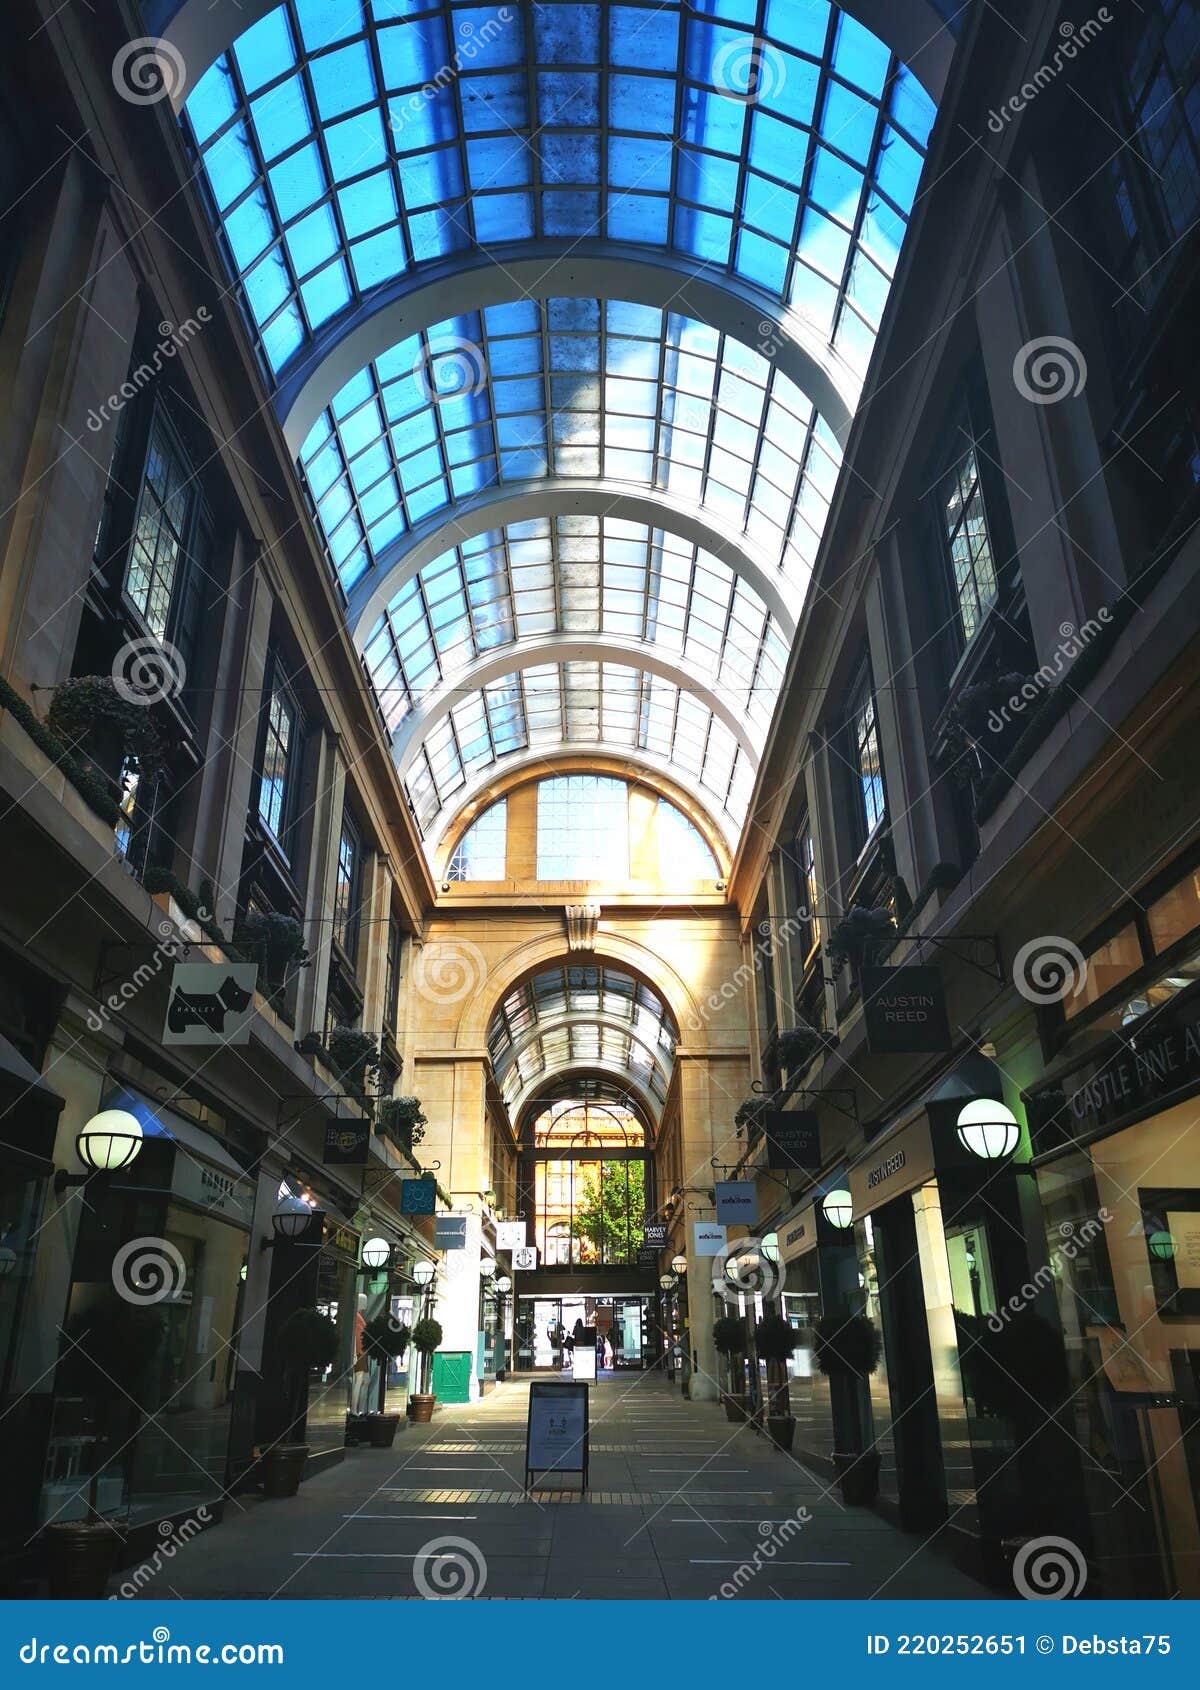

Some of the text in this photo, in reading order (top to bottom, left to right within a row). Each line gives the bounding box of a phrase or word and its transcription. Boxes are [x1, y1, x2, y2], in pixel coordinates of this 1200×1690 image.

[876, 994, 935, 1008] AUSTIN
[885, 1010, 928, 1023] REED
[1072, 1065, 1132, 1119] CASTLE
[1135, 1036, 1181, 1086] FINE
